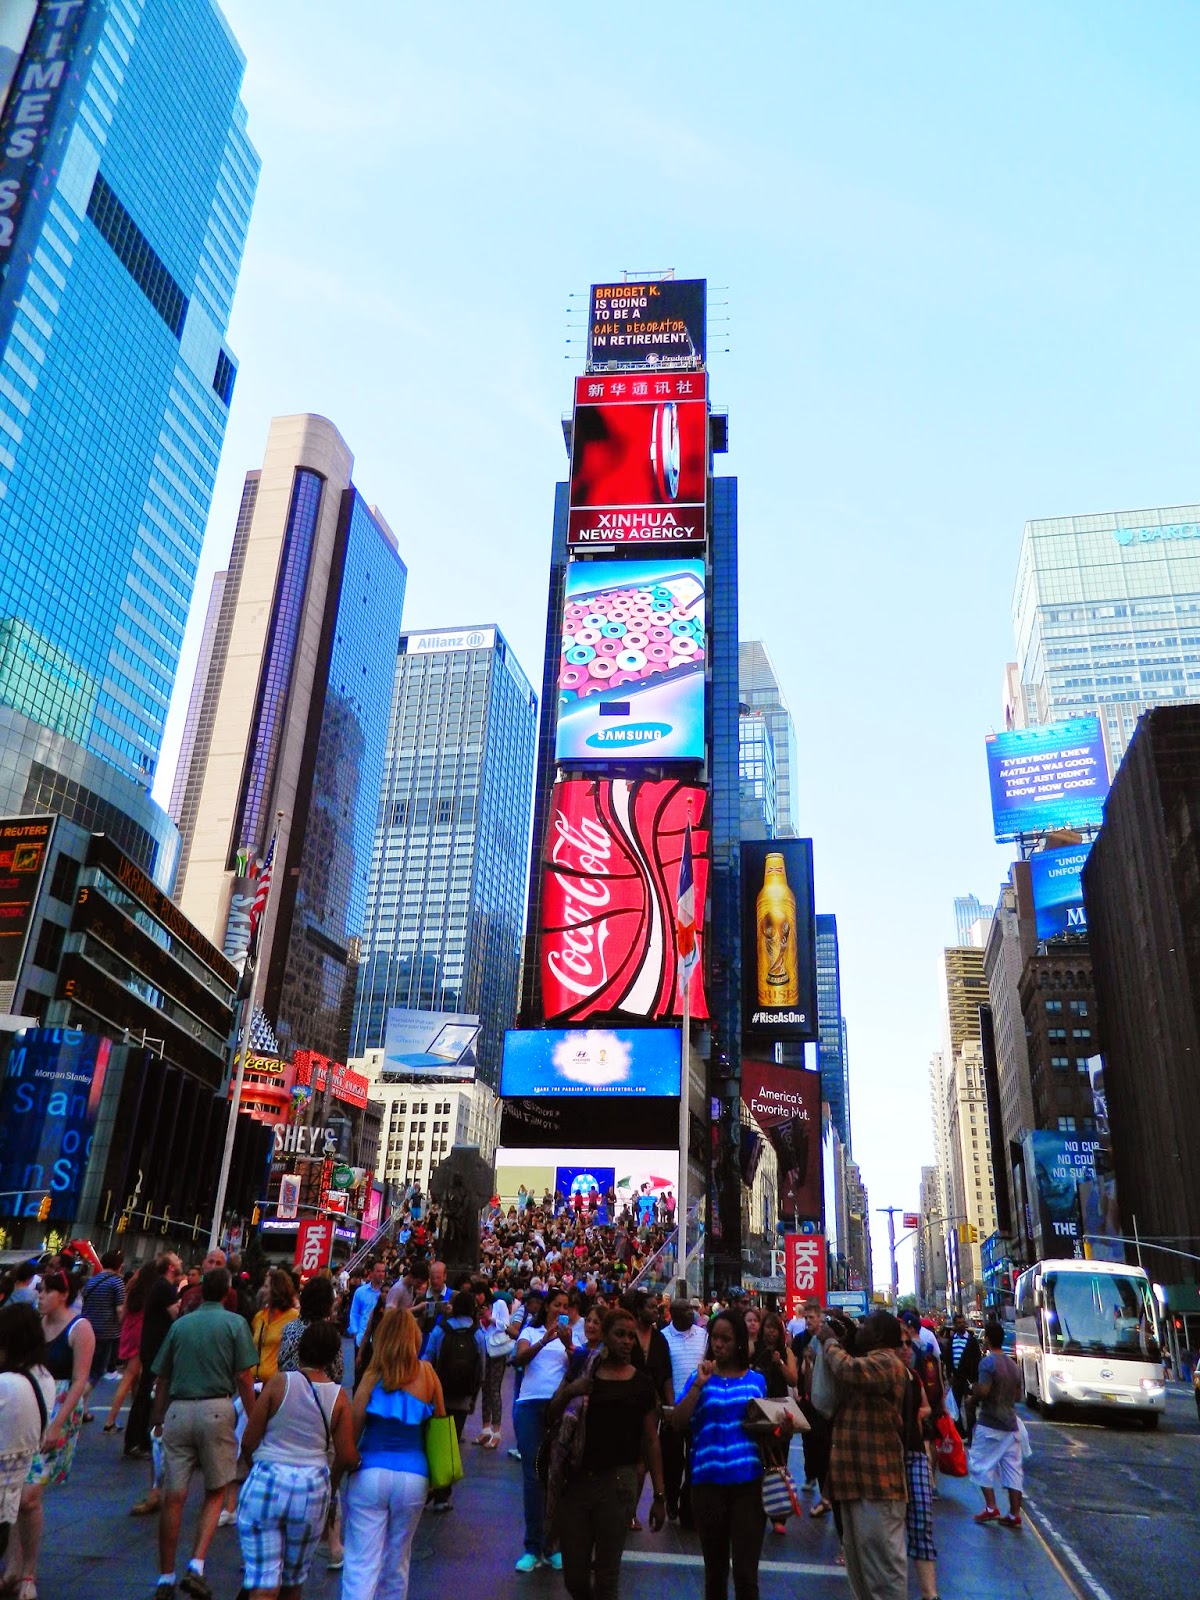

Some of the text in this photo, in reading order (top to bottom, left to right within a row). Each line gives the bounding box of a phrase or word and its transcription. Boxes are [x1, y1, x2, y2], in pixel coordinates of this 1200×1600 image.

[6, 1, 83, 158] TIMES
[595, 285, 661, 299] BRIDGET K.
[595, 297, 648, 309] IS GOING
[594, 309, 641, 320] TO BE A
[594, 318, 685, 335] CAKE DECORATOR
[593, 333, 689, 347] IN RETIREMENT.
[588, 380, 693, 398] 新华通讯社
[596, 512, 677, 528] XINHUA
[579, 526, 695, 540] NEWS AGENCY
[417, 636, 464, 650] Allianz
[597, 729, 663, 741] SAMSUNG
[1060, 747, 1090, 758] KNEW
[1000, 757, 1097, 778] MATILDA WAS GOOD,
[1005, 768, 1090, 787] THEY JUST DIDN'T
[1006, 786, 1037, 798] KNOW
[1038, 783, 1063, 793] HOW
[4, 825, 48, 837] REUTERS
[1048, 865, 1084, 878] UNFOR
[752, 1011, 806, 1024] #RiseAsOne
[35, 1069, 93, 1085] Morgan Stanley
[759, 1086, 803, 1105] America's
[751, 1098, 790, 1117] Favorite
[1064, 1141, 1079, 1152] NO
[1057, 1154, 1071, 1164] NO
[1053, 1168, 1067, 1178] NO
[1052, 1222, 1077, 1236] THE
[302, 1225, 328, 1271] tkts
[795, 1239, 820, 1291] tkts
